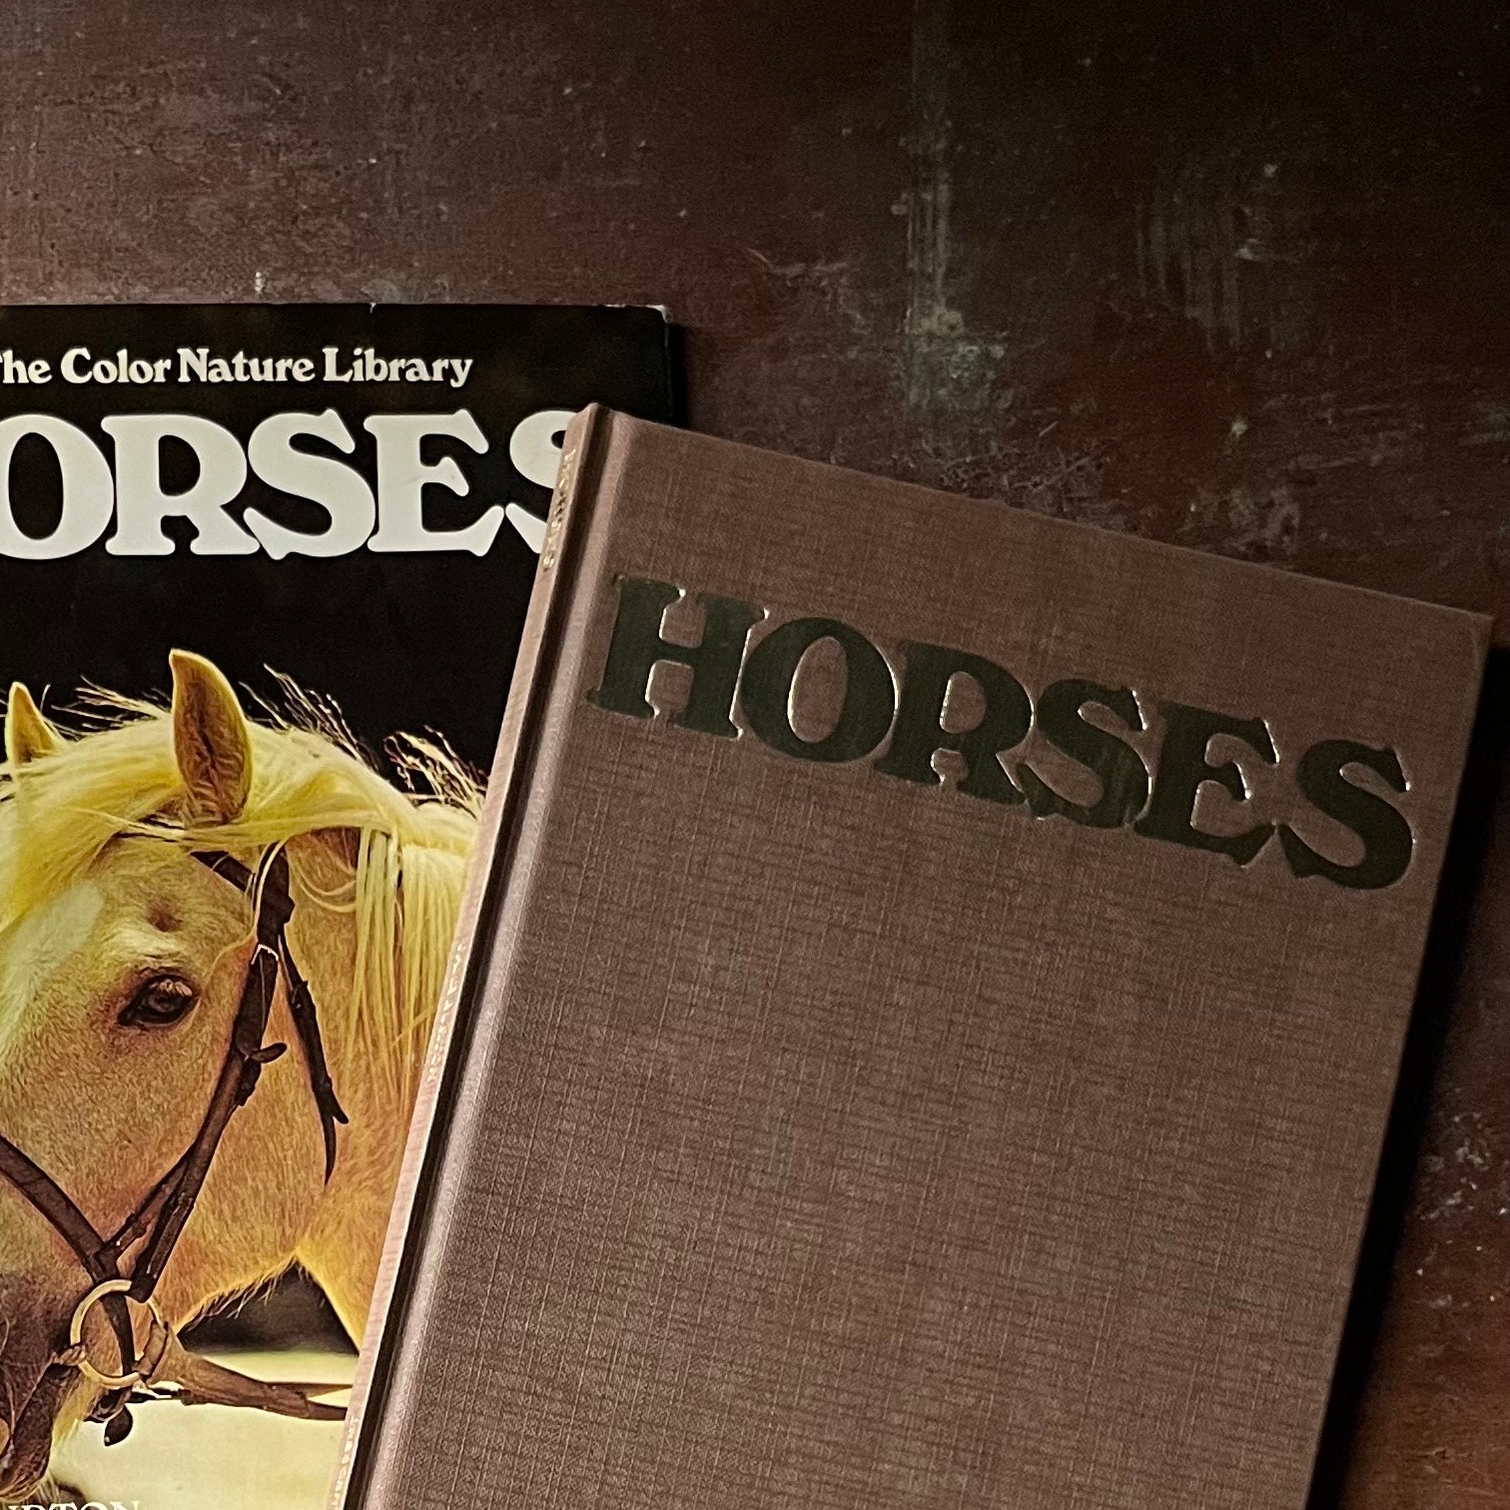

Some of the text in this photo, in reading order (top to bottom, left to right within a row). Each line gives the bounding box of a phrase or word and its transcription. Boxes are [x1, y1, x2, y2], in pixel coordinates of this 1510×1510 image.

[61, 347, 171, 384] Color
[177, 347, 316, 384] Nature
[323, 347, 472, 387] Library
[587, 574, 1417, 891] HORSES
